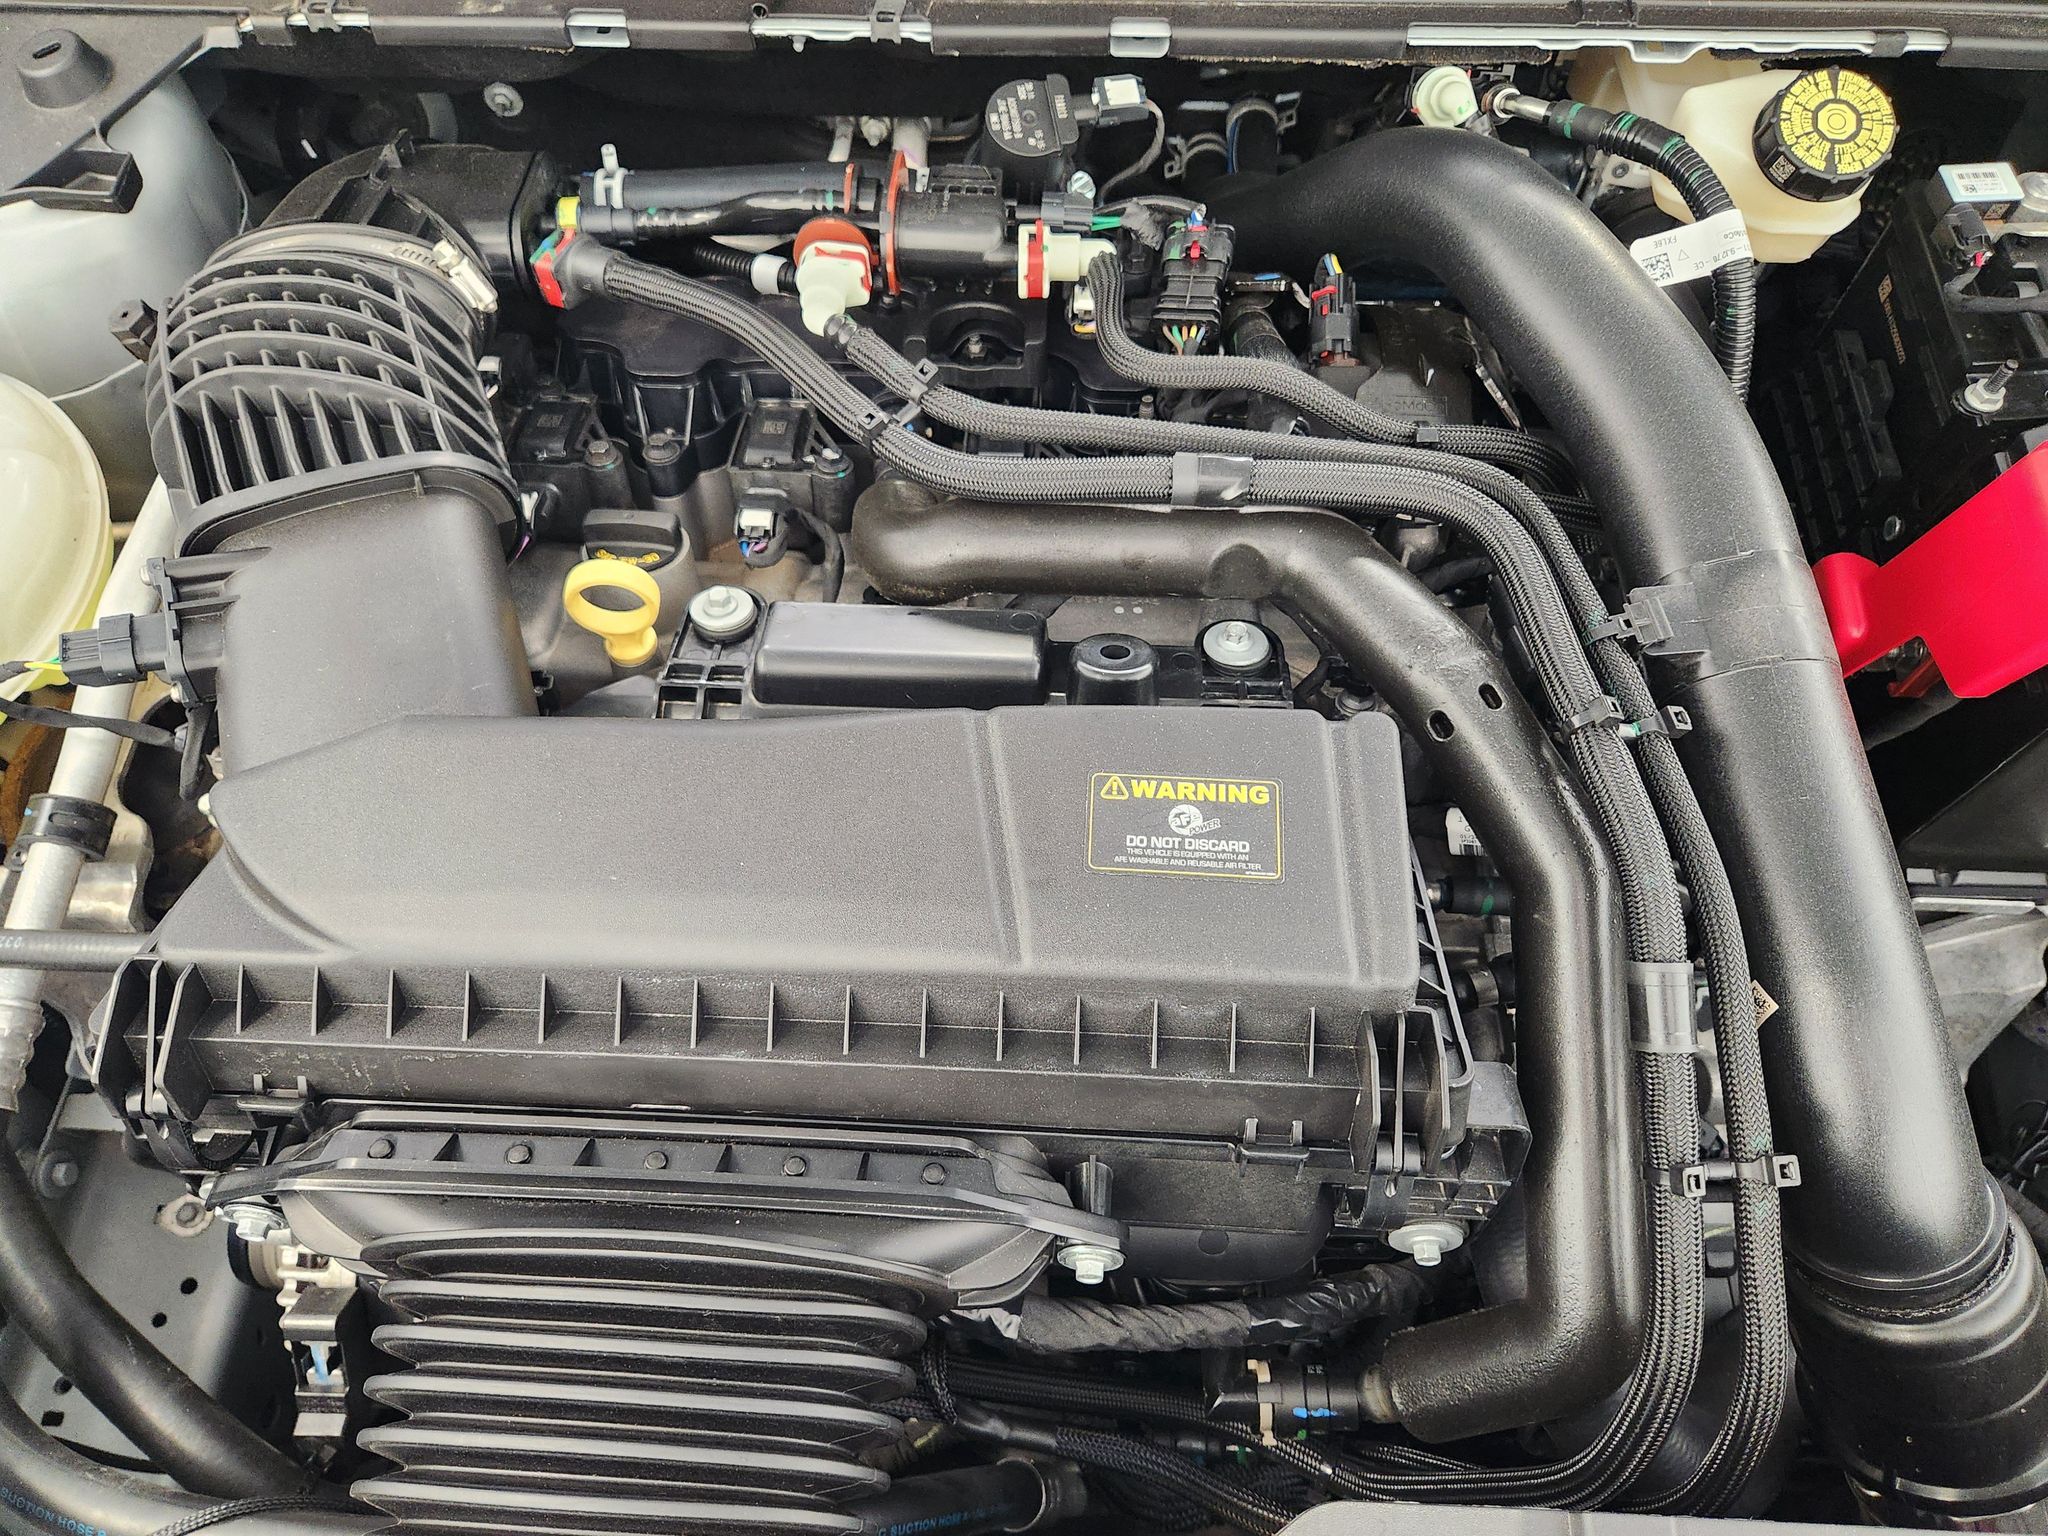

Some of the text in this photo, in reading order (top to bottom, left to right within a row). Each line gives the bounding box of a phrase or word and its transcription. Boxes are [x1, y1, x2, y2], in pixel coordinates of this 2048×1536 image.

[1130, 779, 1270, 804] WARNING
[1189, 820, 1220, 834] POWER
[1126, 835, 1250, 852] DO NOT DISCARD
[1129, 856, 1169, 865] WASHABLE
[1187, 860, 1224, 868] REUSABLE
[1144, 849, 1172, 857] VEHICLE
[1181, 850, 1217, 859] EQUIPPED
[1, 1486, 94, 1536] SUCTION HOSE
[890, 1518, 937, 1536] SUCTION
